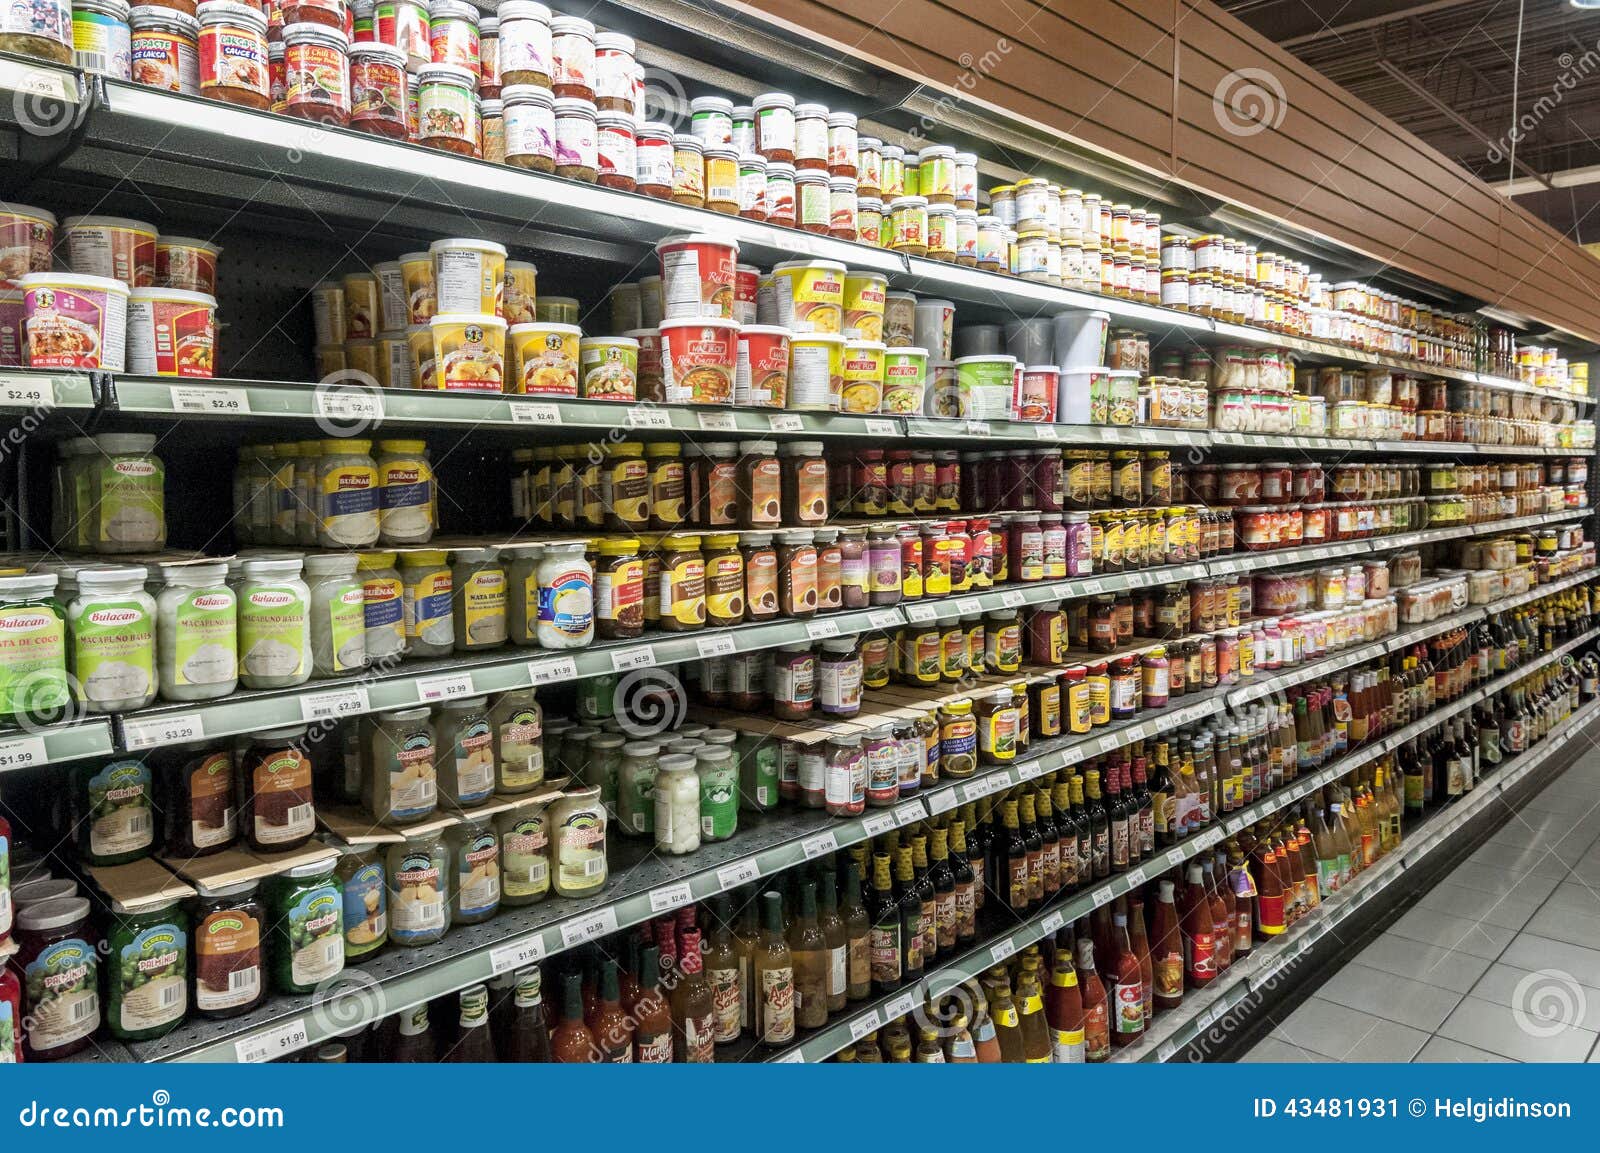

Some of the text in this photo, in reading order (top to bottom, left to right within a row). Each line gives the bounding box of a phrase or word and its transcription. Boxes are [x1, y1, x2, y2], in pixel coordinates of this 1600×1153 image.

[8, 390, 41, 400] $2.49
[212, 400, 239, 409] $2.49
[194, 597, 230, 606] Bulacan
[251, 593, 290, 603] Bulacan
[0, 616, 46, 628] Bulacan
[91, 611, 136, 622] Bulacan
[18, 636, 31, 646] DE
[35, 634, 59, 645] COCO
[553, 665, 571, 676] $1.99
[446, 684, 466, 694] $2.99
[165, 728, 193, 740] $3.29
[0, 752, 33, 766] $1.99
[586, 922, 604, 934] $2.59
[518, 948, 538, 961] $1.99
[139, 952, 178, 970] PALM NUT
[45, 965, 87, 987] PALM NUT
[280, 1031, 305, 1047] $1.99
